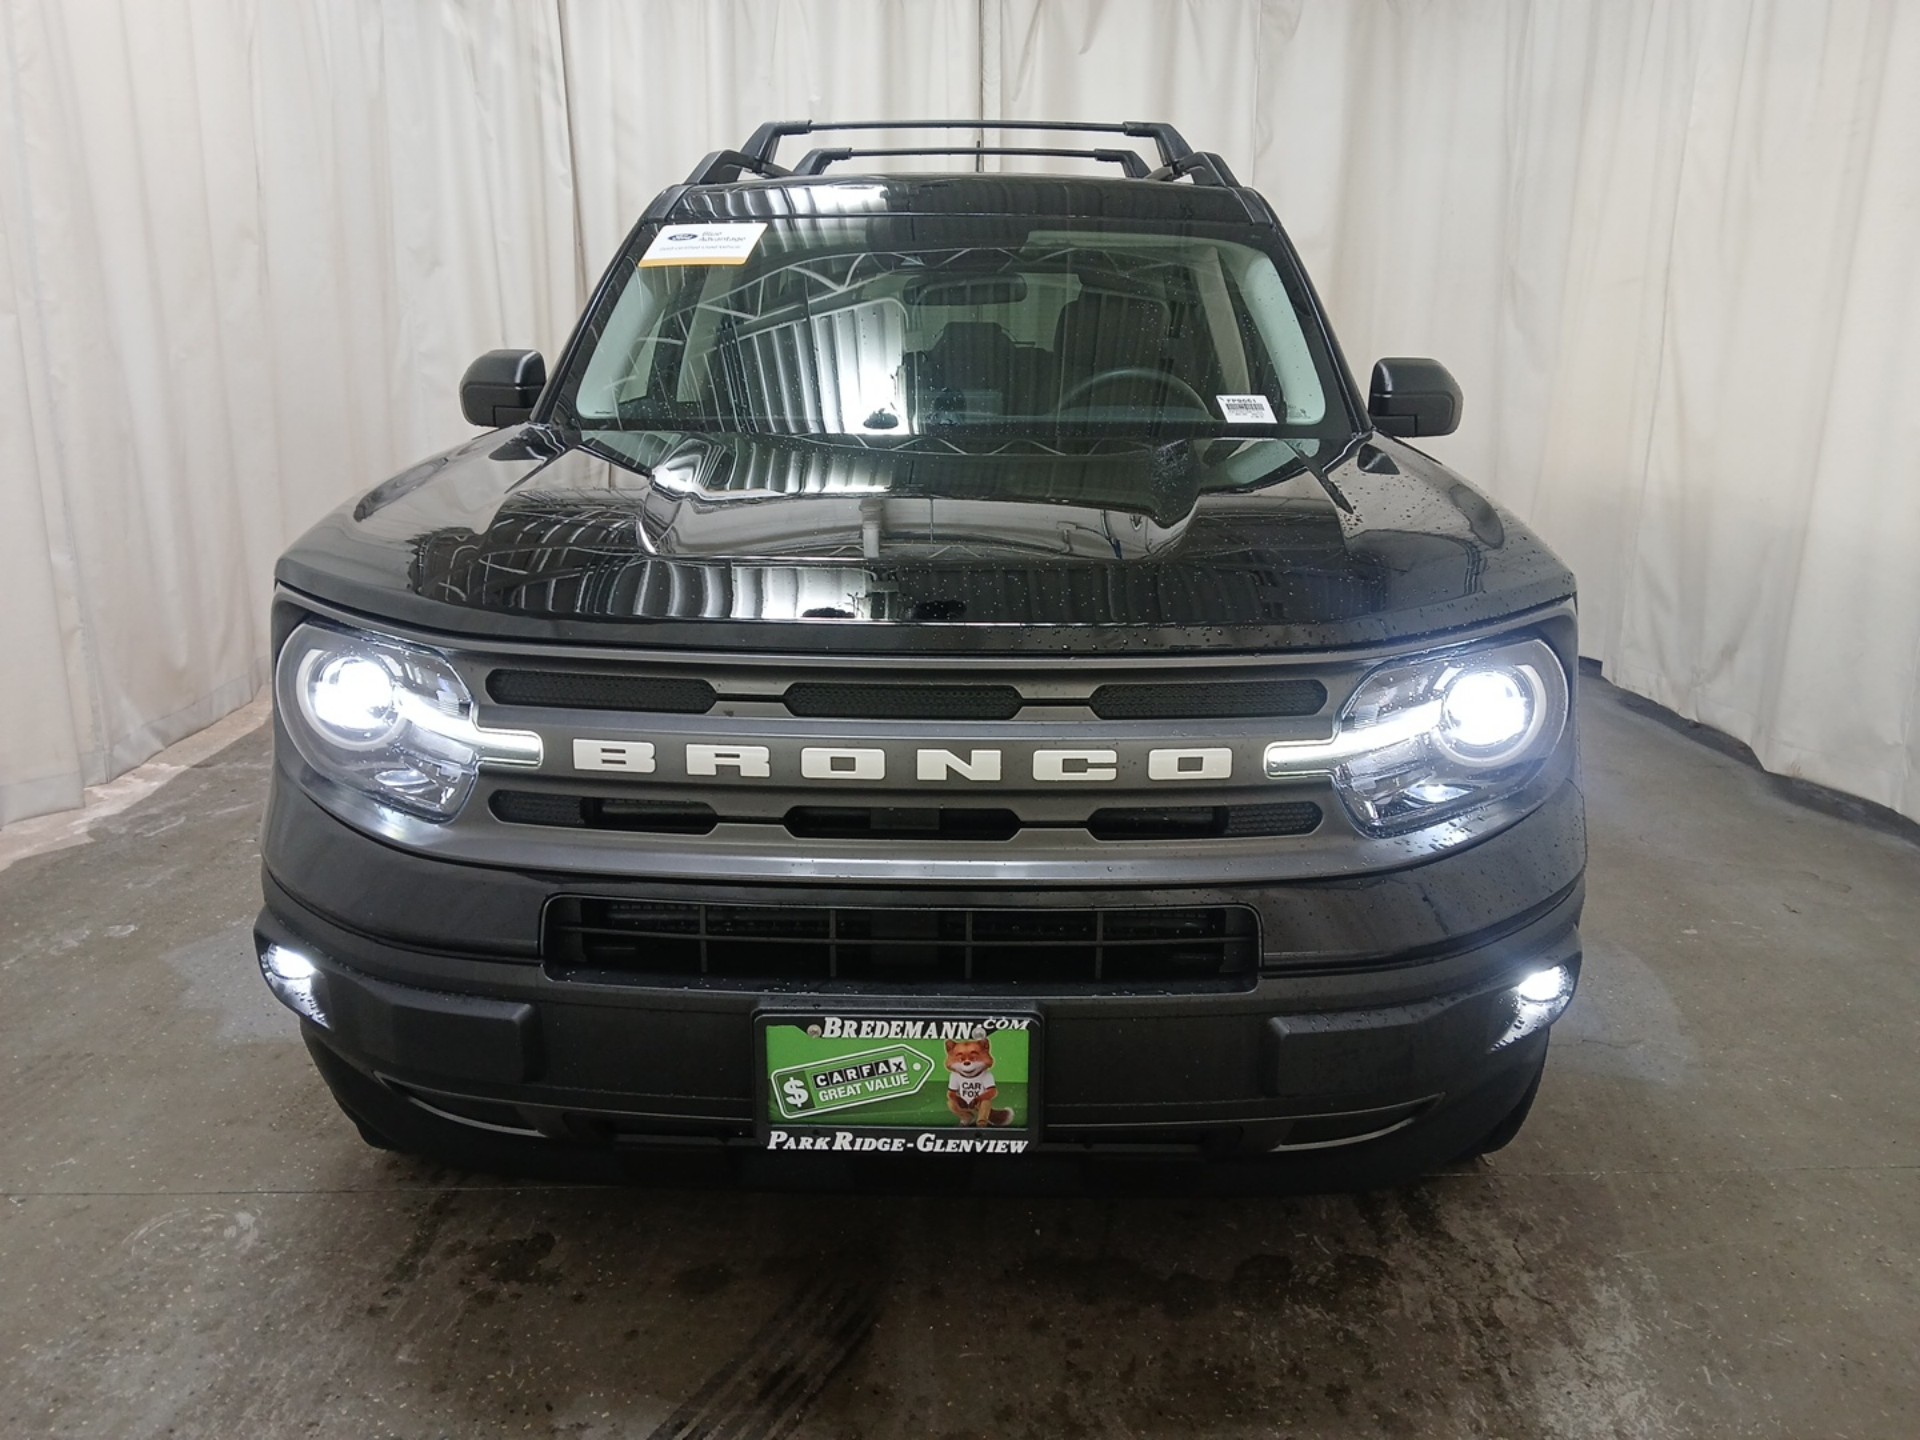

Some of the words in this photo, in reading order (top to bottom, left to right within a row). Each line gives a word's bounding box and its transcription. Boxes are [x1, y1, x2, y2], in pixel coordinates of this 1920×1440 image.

[573, 738, 1233, 781] BRONCO
[815, 1058, 907, 1087] CARFAX
[818, 1082, 862, 1103] GREAT
[865, 1073, 910, 1092] VALUE
[962, 1082, 982, 1091] CAR
[962, 1090, 980, 1098] FOX
[767, 1131, 831, 1150] PARK
